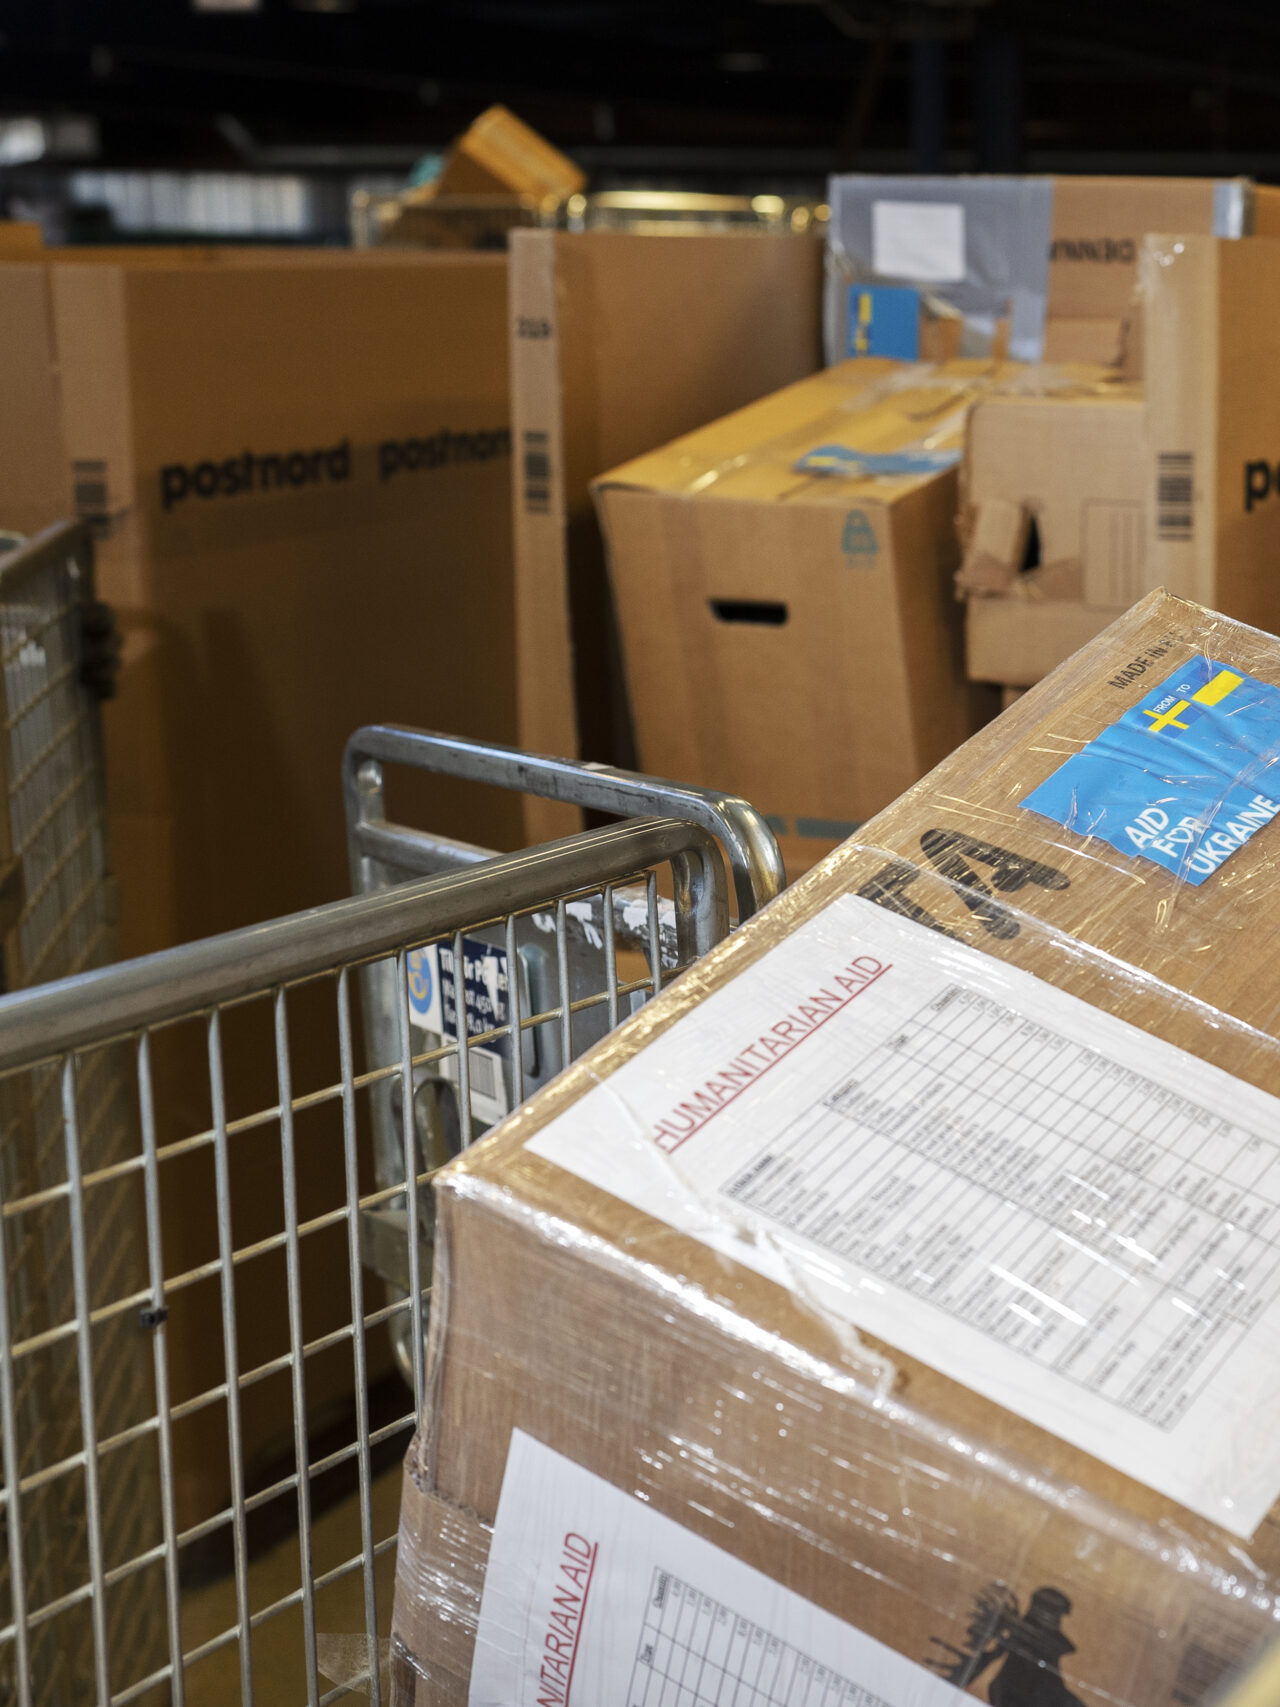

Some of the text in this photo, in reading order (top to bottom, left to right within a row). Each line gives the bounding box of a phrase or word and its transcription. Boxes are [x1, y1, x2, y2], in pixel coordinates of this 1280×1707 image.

[162, 428, 512, 512] postnord postnor
[1107, 656, 1154, 690] MADE
[1144, 646, 1168, 659] IN
[1153, 684, 1191, 712] FROM TO
[1124, 808, 1169, 849] AID
[1152, 817, 1210, 858] FOR
[653, 988, 845, 1152] HUMANITARIAN
[834, 955, 882, 994] AID
[537, 1532, 592, 1707] NITARIAN AID
